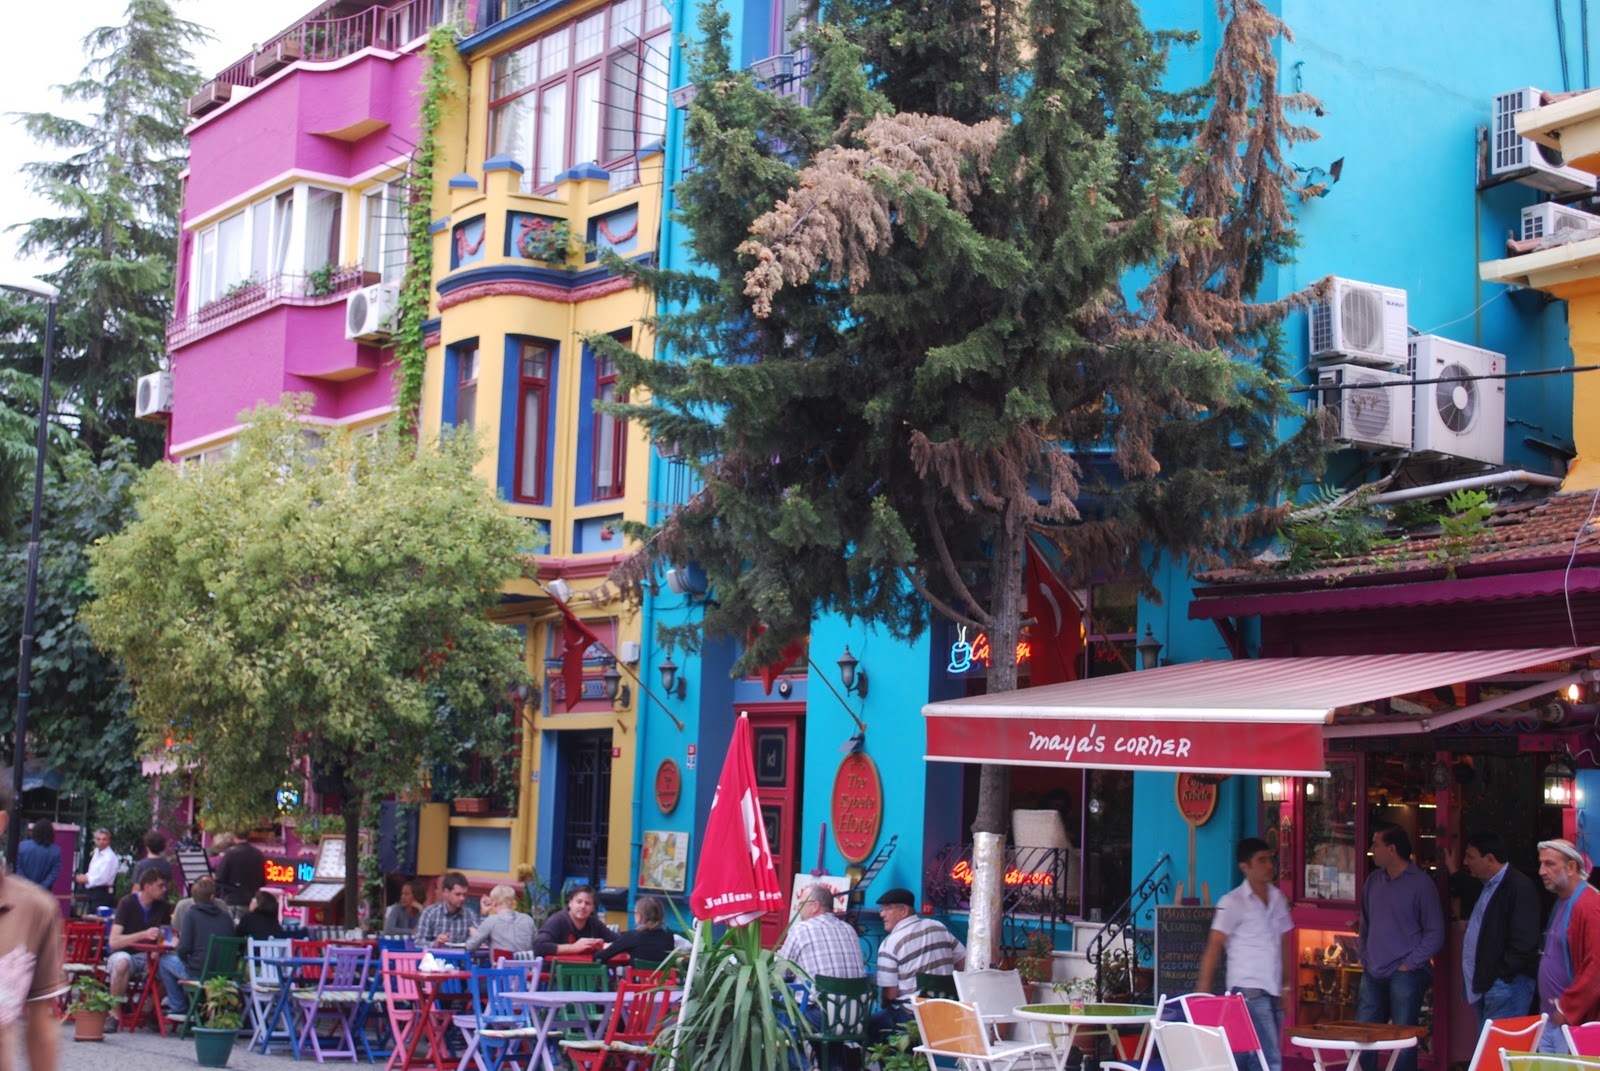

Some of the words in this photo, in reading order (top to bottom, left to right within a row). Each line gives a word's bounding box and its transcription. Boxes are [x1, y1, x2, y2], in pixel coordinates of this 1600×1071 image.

[1028, 723, 1106, 761] maya's
[847, 773, 868, 789] The
[838, 812, 878, 835] Hotel
[703, 892, 753, 909] Julius
